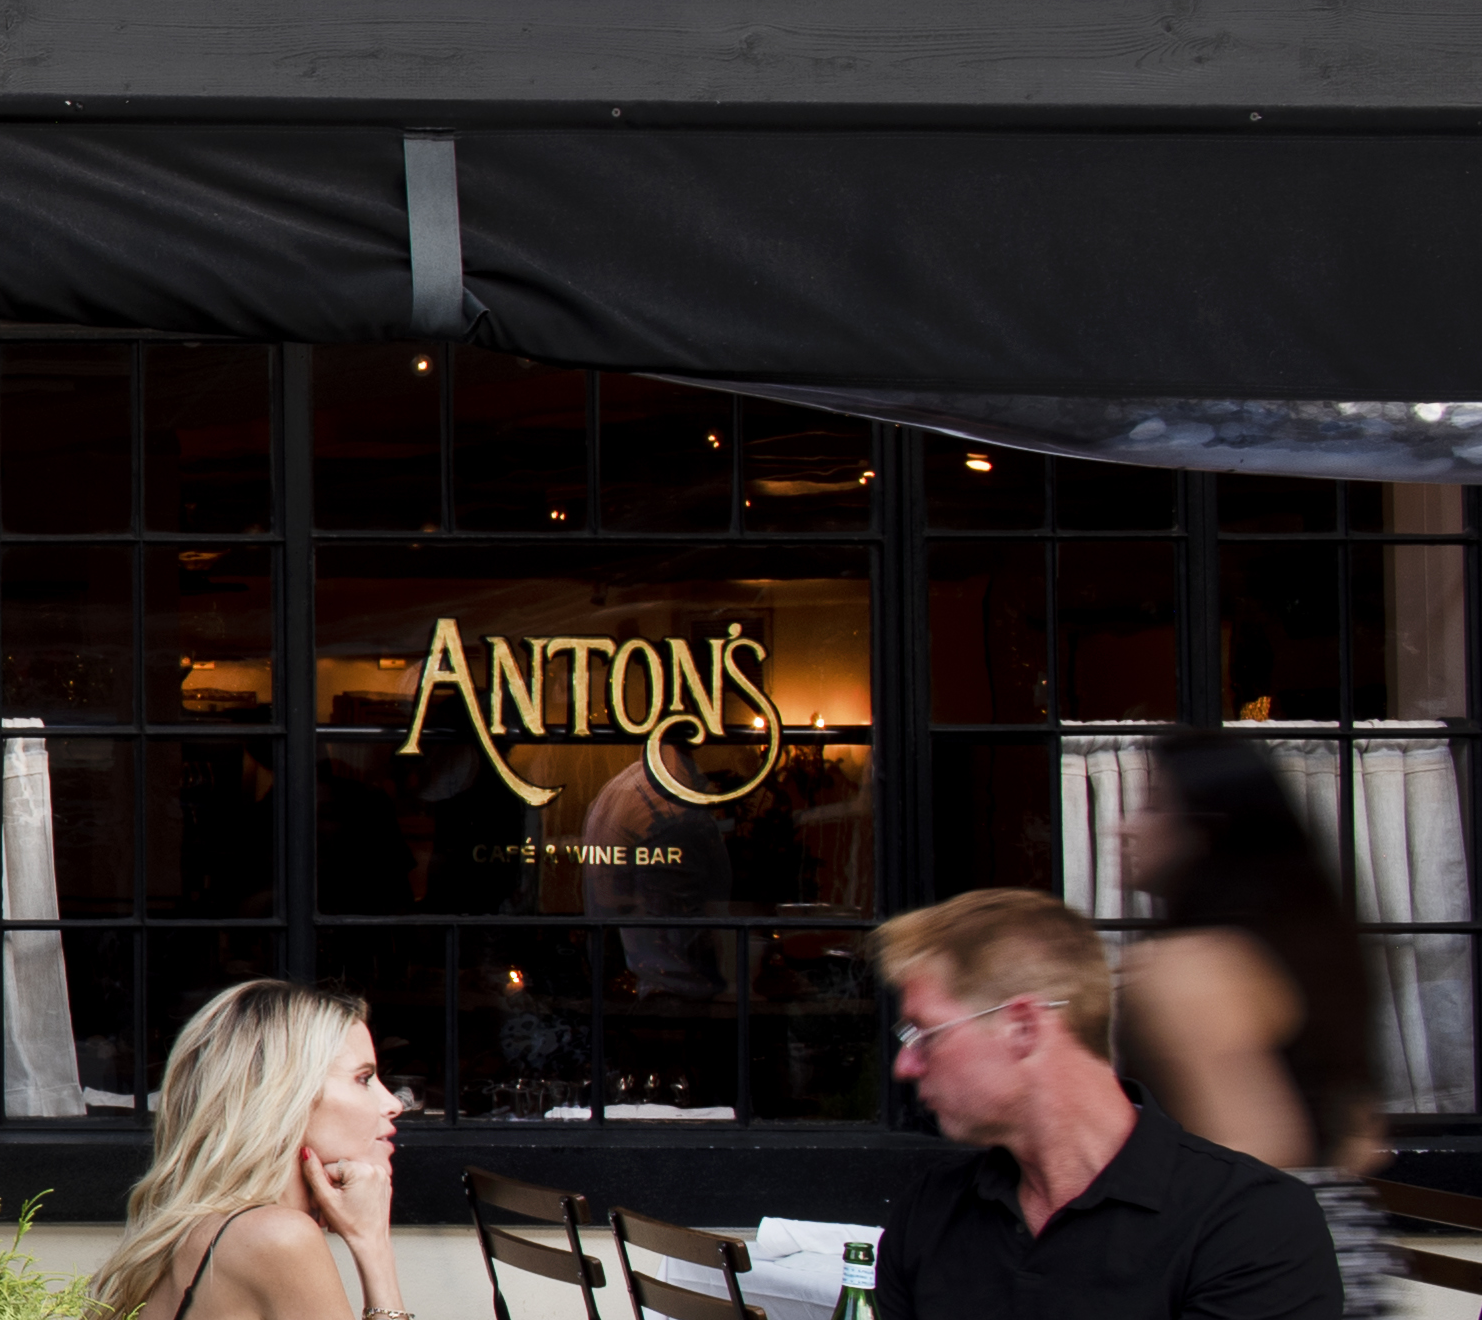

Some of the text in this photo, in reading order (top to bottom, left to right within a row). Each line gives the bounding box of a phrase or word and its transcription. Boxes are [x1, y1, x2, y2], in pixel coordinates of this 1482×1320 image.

[395, 618, 782, 807] ANTON'S
[472, 837, 683, 865] CAFÉ & WINE BAR
